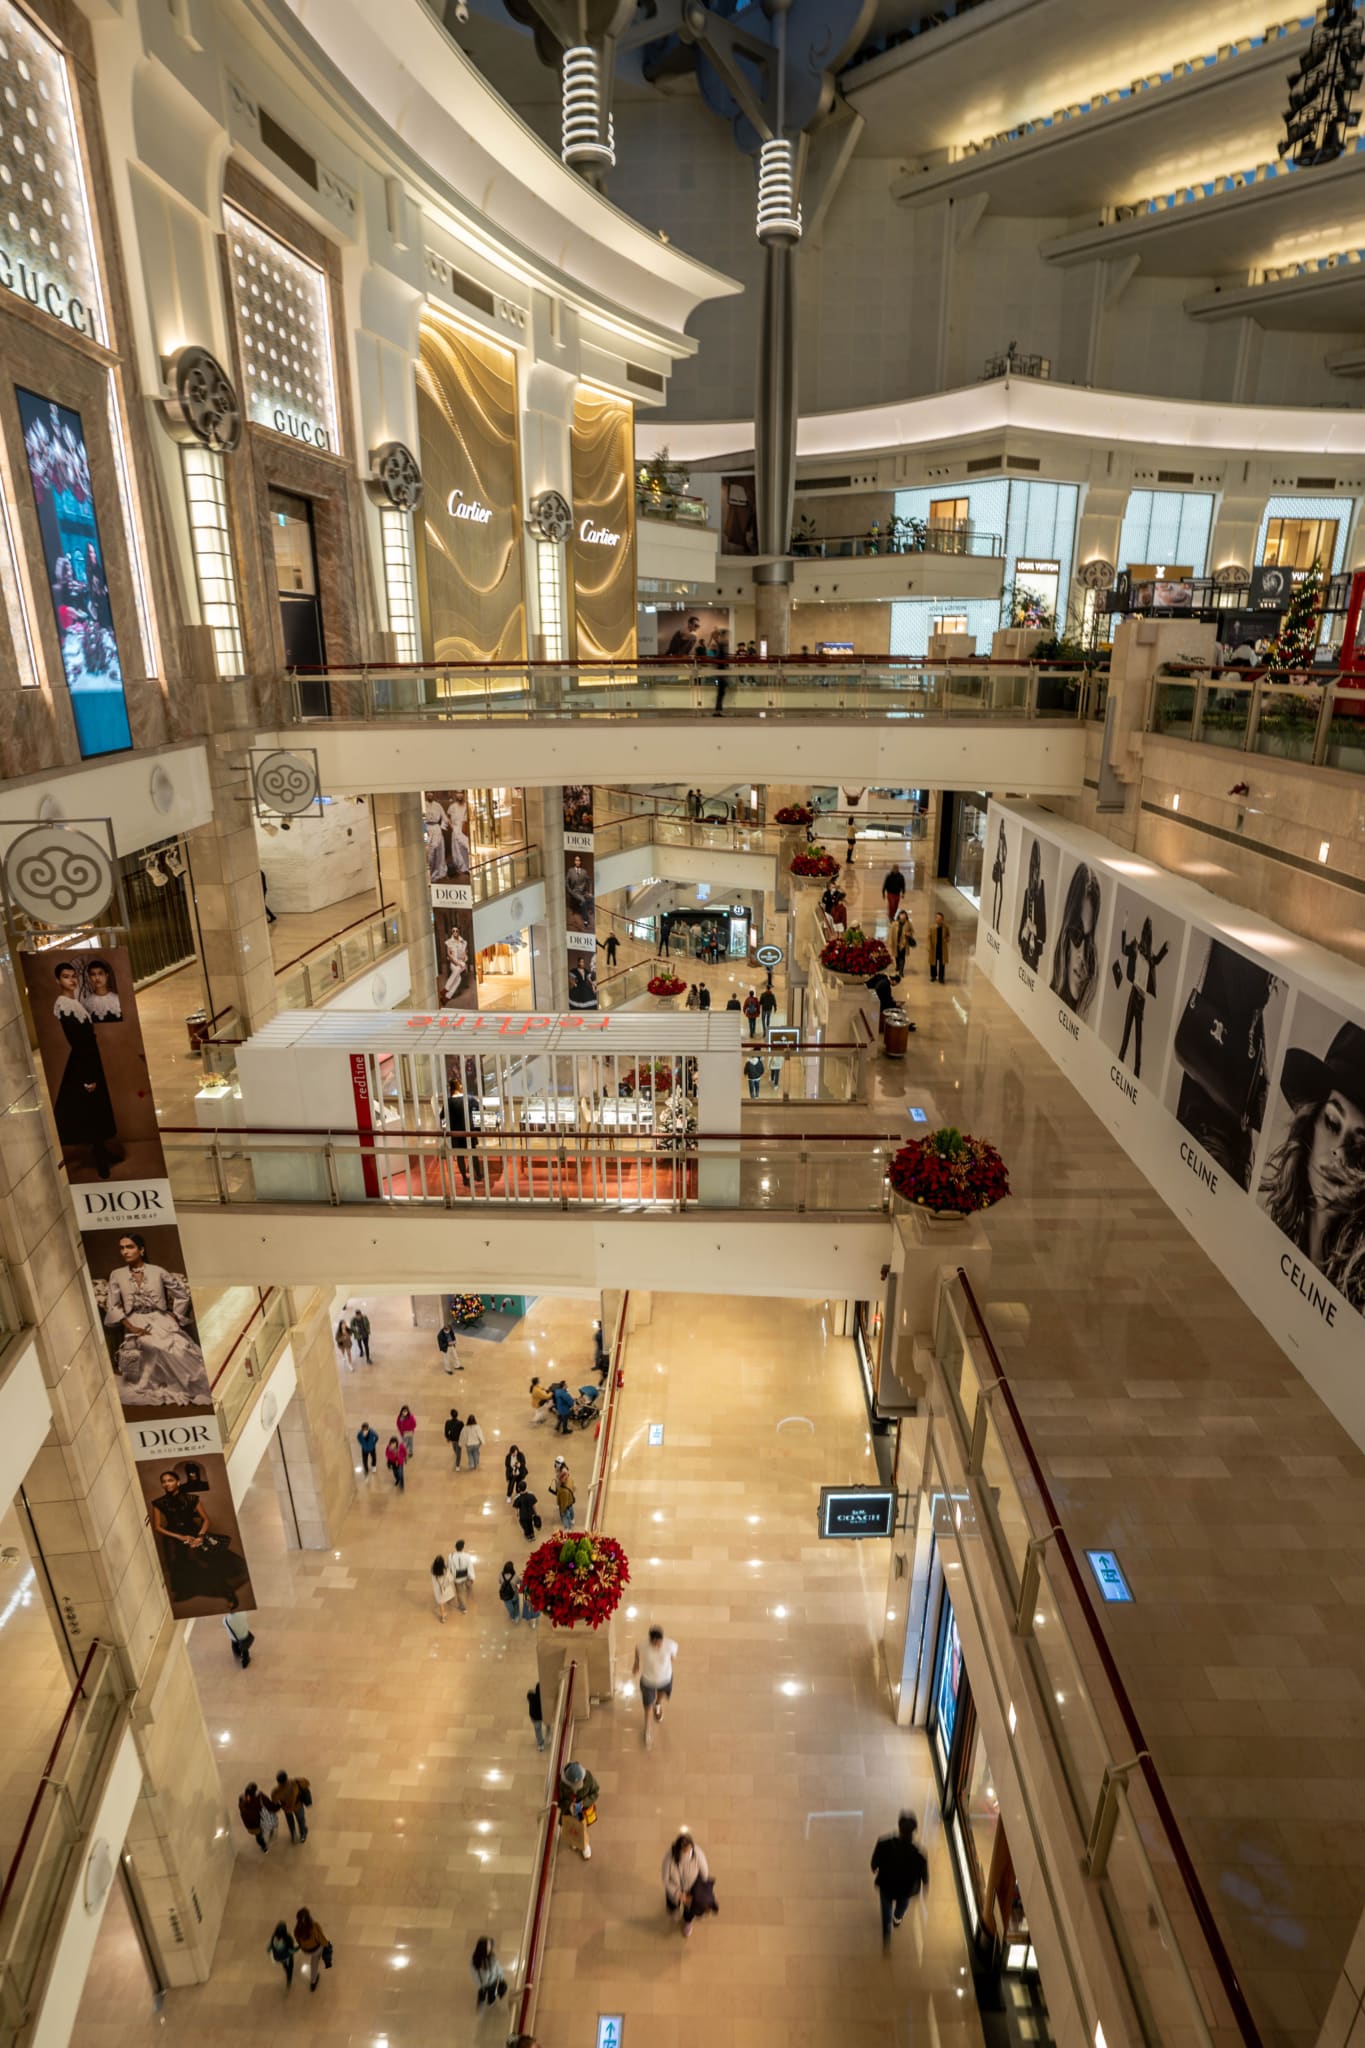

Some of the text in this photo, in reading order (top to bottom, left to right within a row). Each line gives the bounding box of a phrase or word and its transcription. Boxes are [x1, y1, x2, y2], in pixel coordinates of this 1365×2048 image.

[274, 410, 332, 452] GUCCI
[447, 489, 493, 524] Cartier
[580, 519, 621, 547] Cartier
[567, 835, 592, 847] DIOR
[436, 888, 467, 901] DIOR
[569, 935, 593, 946] DIOR
[986, 932, 1001, 955] CELINE
[1018, 966, 1036, 993] CELINE
[1058, 1009, 1080, 1041] CELINE
[1110, 1065, 1138, 1105] CELINE
[1180, 1142, 1218, 1195] CELINE
[83, 1189, 165, 1213] DIOR
[1280, 1253, 1338, 1328] CELINE
[137, 1425, 212, 1447] DIOR
[836, 1513, 880, 1522] COACH
